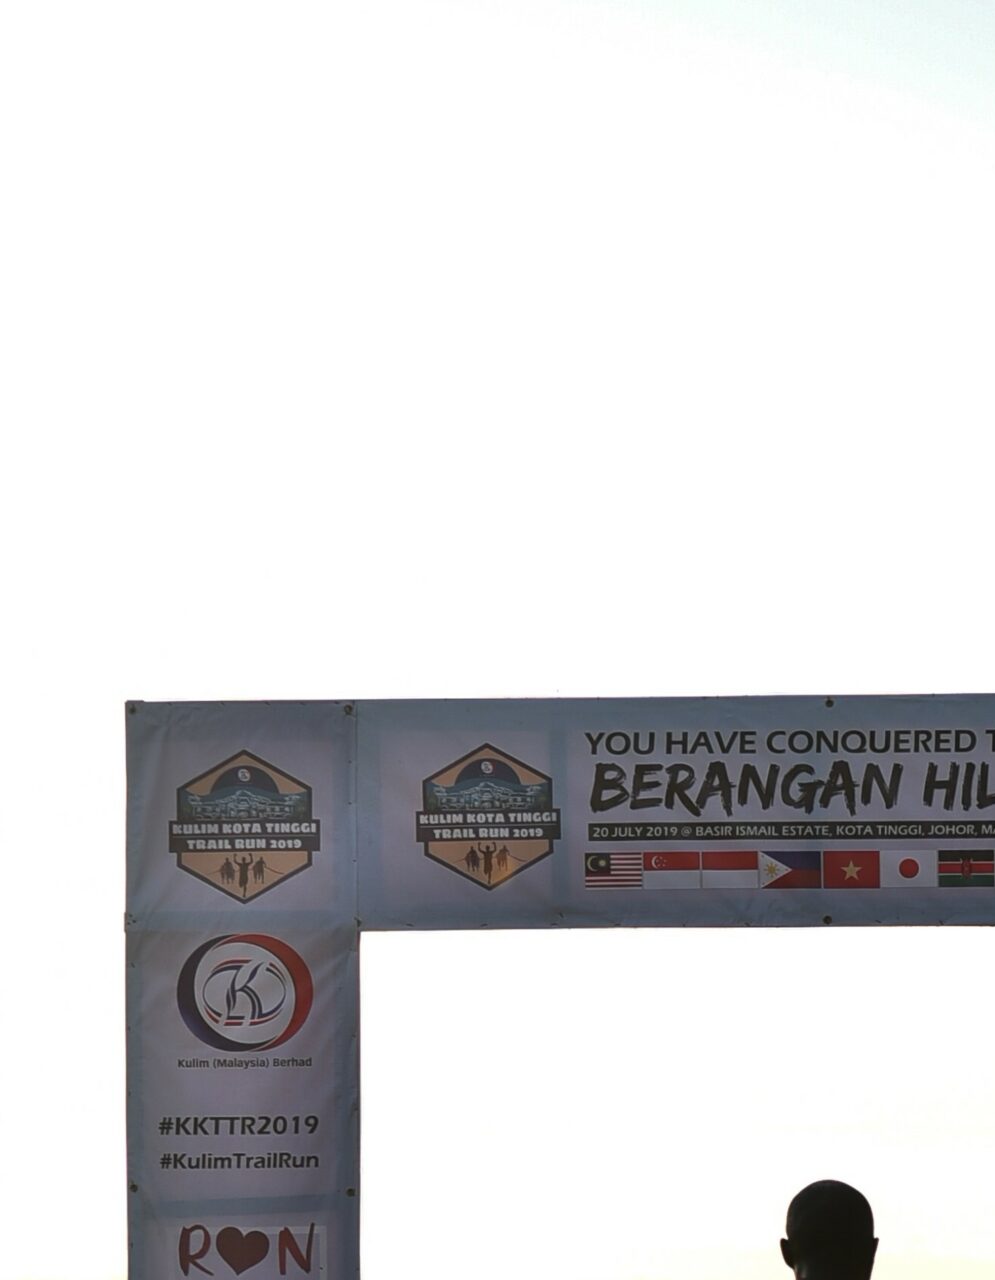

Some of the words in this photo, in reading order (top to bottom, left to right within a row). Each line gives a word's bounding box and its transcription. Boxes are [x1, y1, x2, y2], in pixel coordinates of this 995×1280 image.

[585, 731, 656, 755] YOU
[666, 730, 757, 754] HAVE
[766, 729, 977, 754] CONQUERED
[590, 760, 903, 817] BERANGAN
[419, 814, 463, 824] KULIM
[466, 813, 505, 823] KOTA
[508, 812, 557, 822] TINGGI
[172, 824, 219, 834] KULIM
[222, 823, 262, 834] KOTA
[265, 822, 317, 833] TINGGI
[433, 828, 476, 839] TRAIL
[478, 828, 509, 838] RUN
[513, 828, 544, 837] 2019
[592, 827, 609, 838] 20
[611, 826, 643, 838] JULY
[646, 826, 678, 837] 2019
[696, 826, 732, 837] BASIR
[736, 825, 778, 837] ISMAIL
[782, 825, 832, 837] ESTATE,
[837, 825, 873, 836] KOTA
[876, 824, 925, 837] TINGGI,
[928, 824, 977, 836] JOHOR,
[187, 839, 232, 850] TRAIL
[235, 838, 266, 849] RUN
[270, 838, 302, 848] 2019
[177, 1058, 209, 1068] Kulim
[213, 1058, 269, 1070] (Malaysia)
[272, 1057, 312, 1067] Berhad
[158, 1115, 319, 1136] #KKTTR2019
[160, 1153, 319, 1170] #KulimTrailRun
